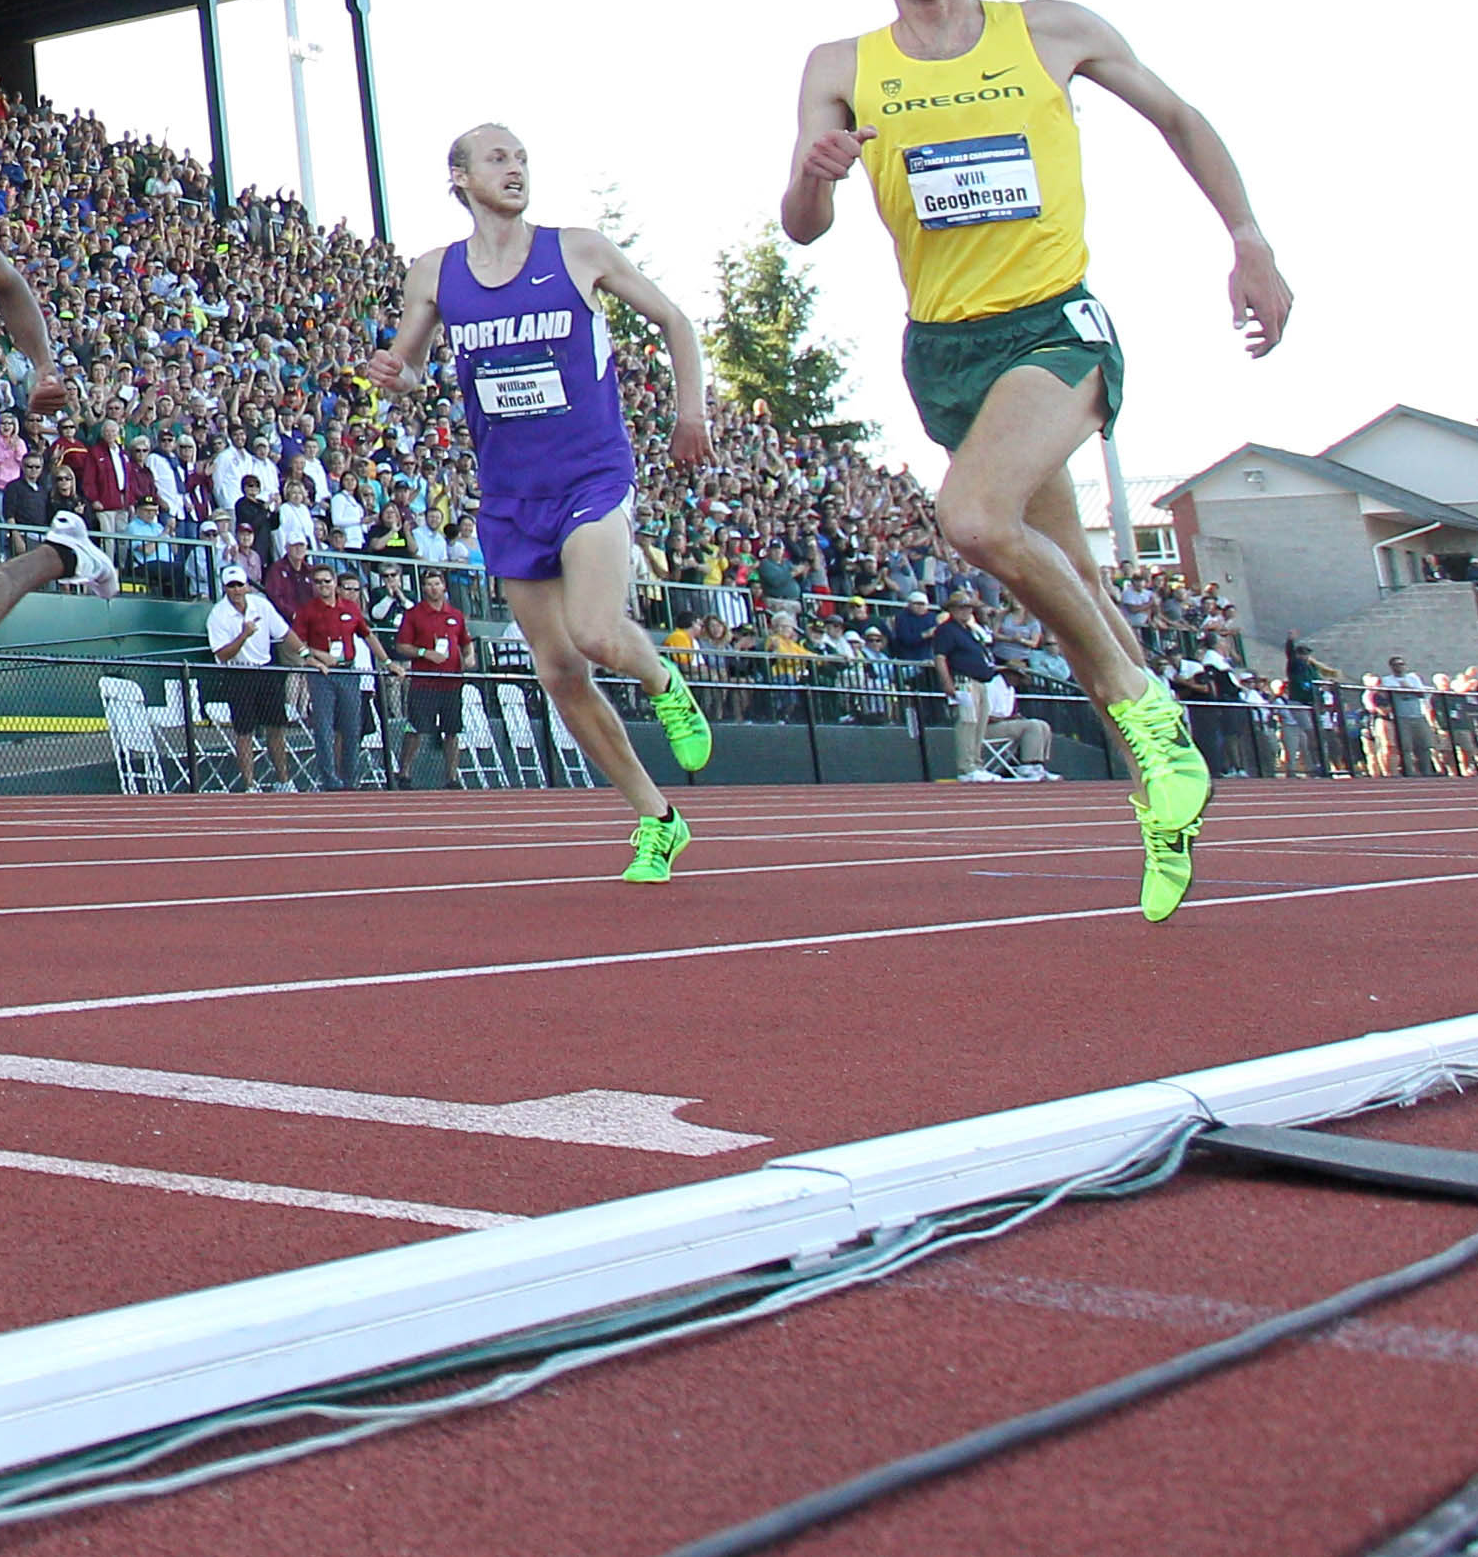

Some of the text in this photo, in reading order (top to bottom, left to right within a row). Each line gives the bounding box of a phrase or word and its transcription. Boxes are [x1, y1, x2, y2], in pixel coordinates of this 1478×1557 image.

[881, 85, 1026, 116] OREGON
[954, 170, 986, 186] Will
[924, 187, 1028, 212] Geoghegan
[450, 309, 573, 355] PORTLAND
[496, 379, 537, 393] William
[496, 392, 545, 408] Kincaid
